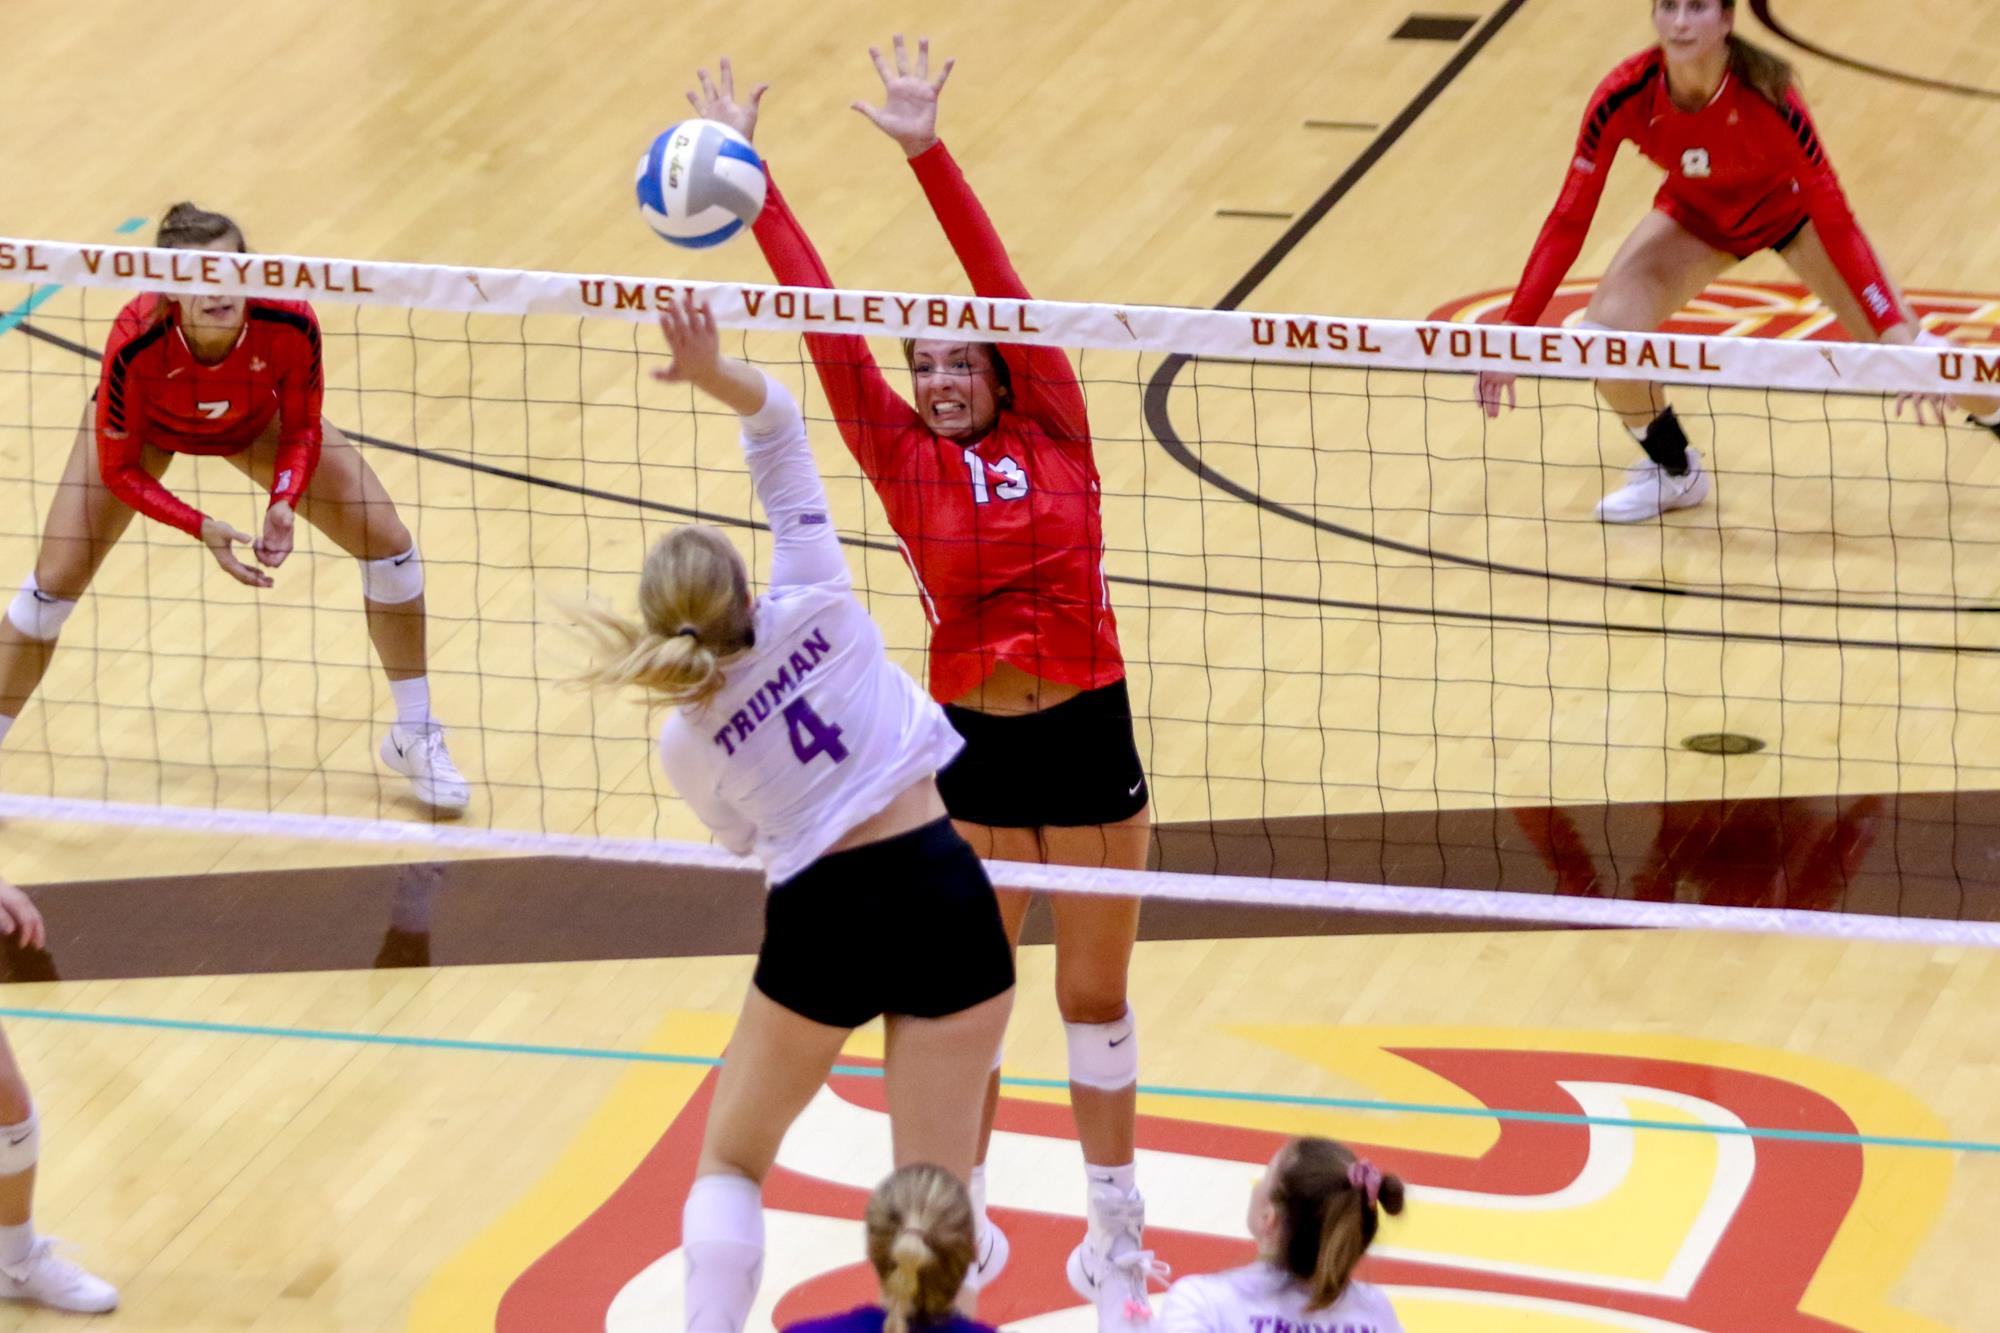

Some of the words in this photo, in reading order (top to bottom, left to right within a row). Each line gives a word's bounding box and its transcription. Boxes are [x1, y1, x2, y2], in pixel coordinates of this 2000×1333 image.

[80, 249, 374, 293] VOLLEYBALL
[741, 289, 1040, 333] VOLLEYBALL
[1250, 317, 1382, 354] UMSL
[1415, 327, 1721, 371] VOLLEYBALL
[1937, 352, 2000, 383] UM
[197, 399, 230, 420] 7
[963, 448, 1030, 504] 13
[713, 627, 831, 757] TRUMAN
[782, 696, 850, 765] 4
